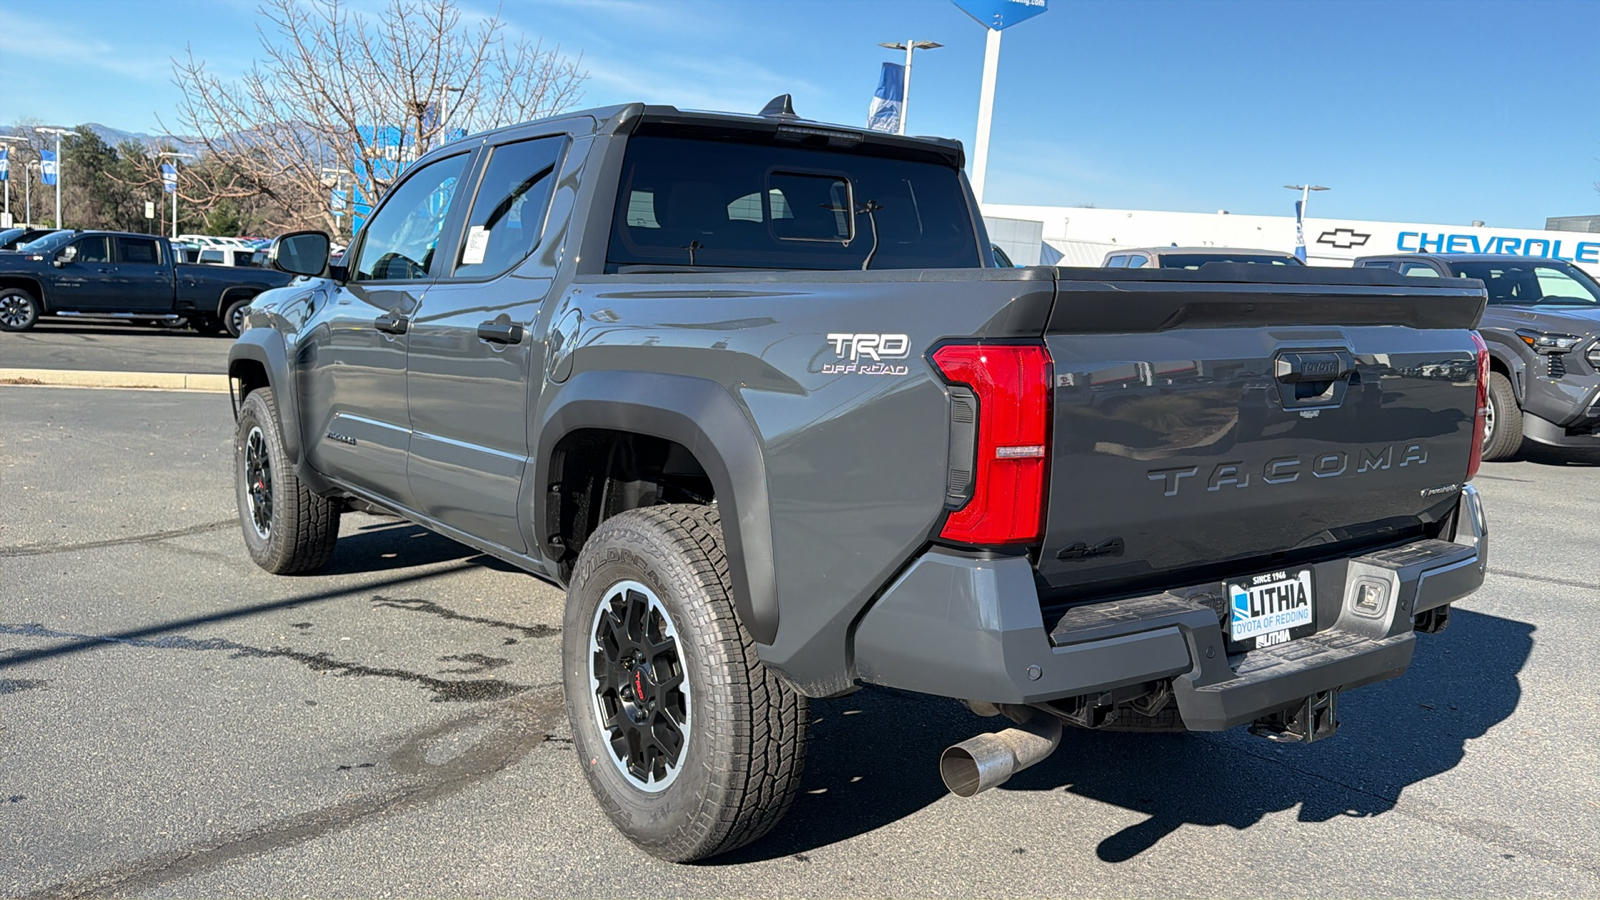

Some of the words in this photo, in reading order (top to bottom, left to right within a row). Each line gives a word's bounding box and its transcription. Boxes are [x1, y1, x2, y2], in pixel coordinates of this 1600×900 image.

[1397, 231, 1600, 264] CHEVROLE
[826, 333, 910, 363] TRD
[821, 363, 857, 375] OFF
[857, 364, 910, 376] ROAD
[1302, 360, 1336, 374] TOYOTA
[1147, 444, 1429, 497] TACOMA
[1252, 573, 1272, 585] SINCE
[1271, 570, 1287, 581] 1946
[1249, 581, 1308, 618] LITHIA
[1231, 619, 1262, 635] TOYOTA
[1263, 616, 1275, 628] OF
[1275, 608, 1309, 624] REDDING
[1263, 628, 1291, 647] LITHIA
